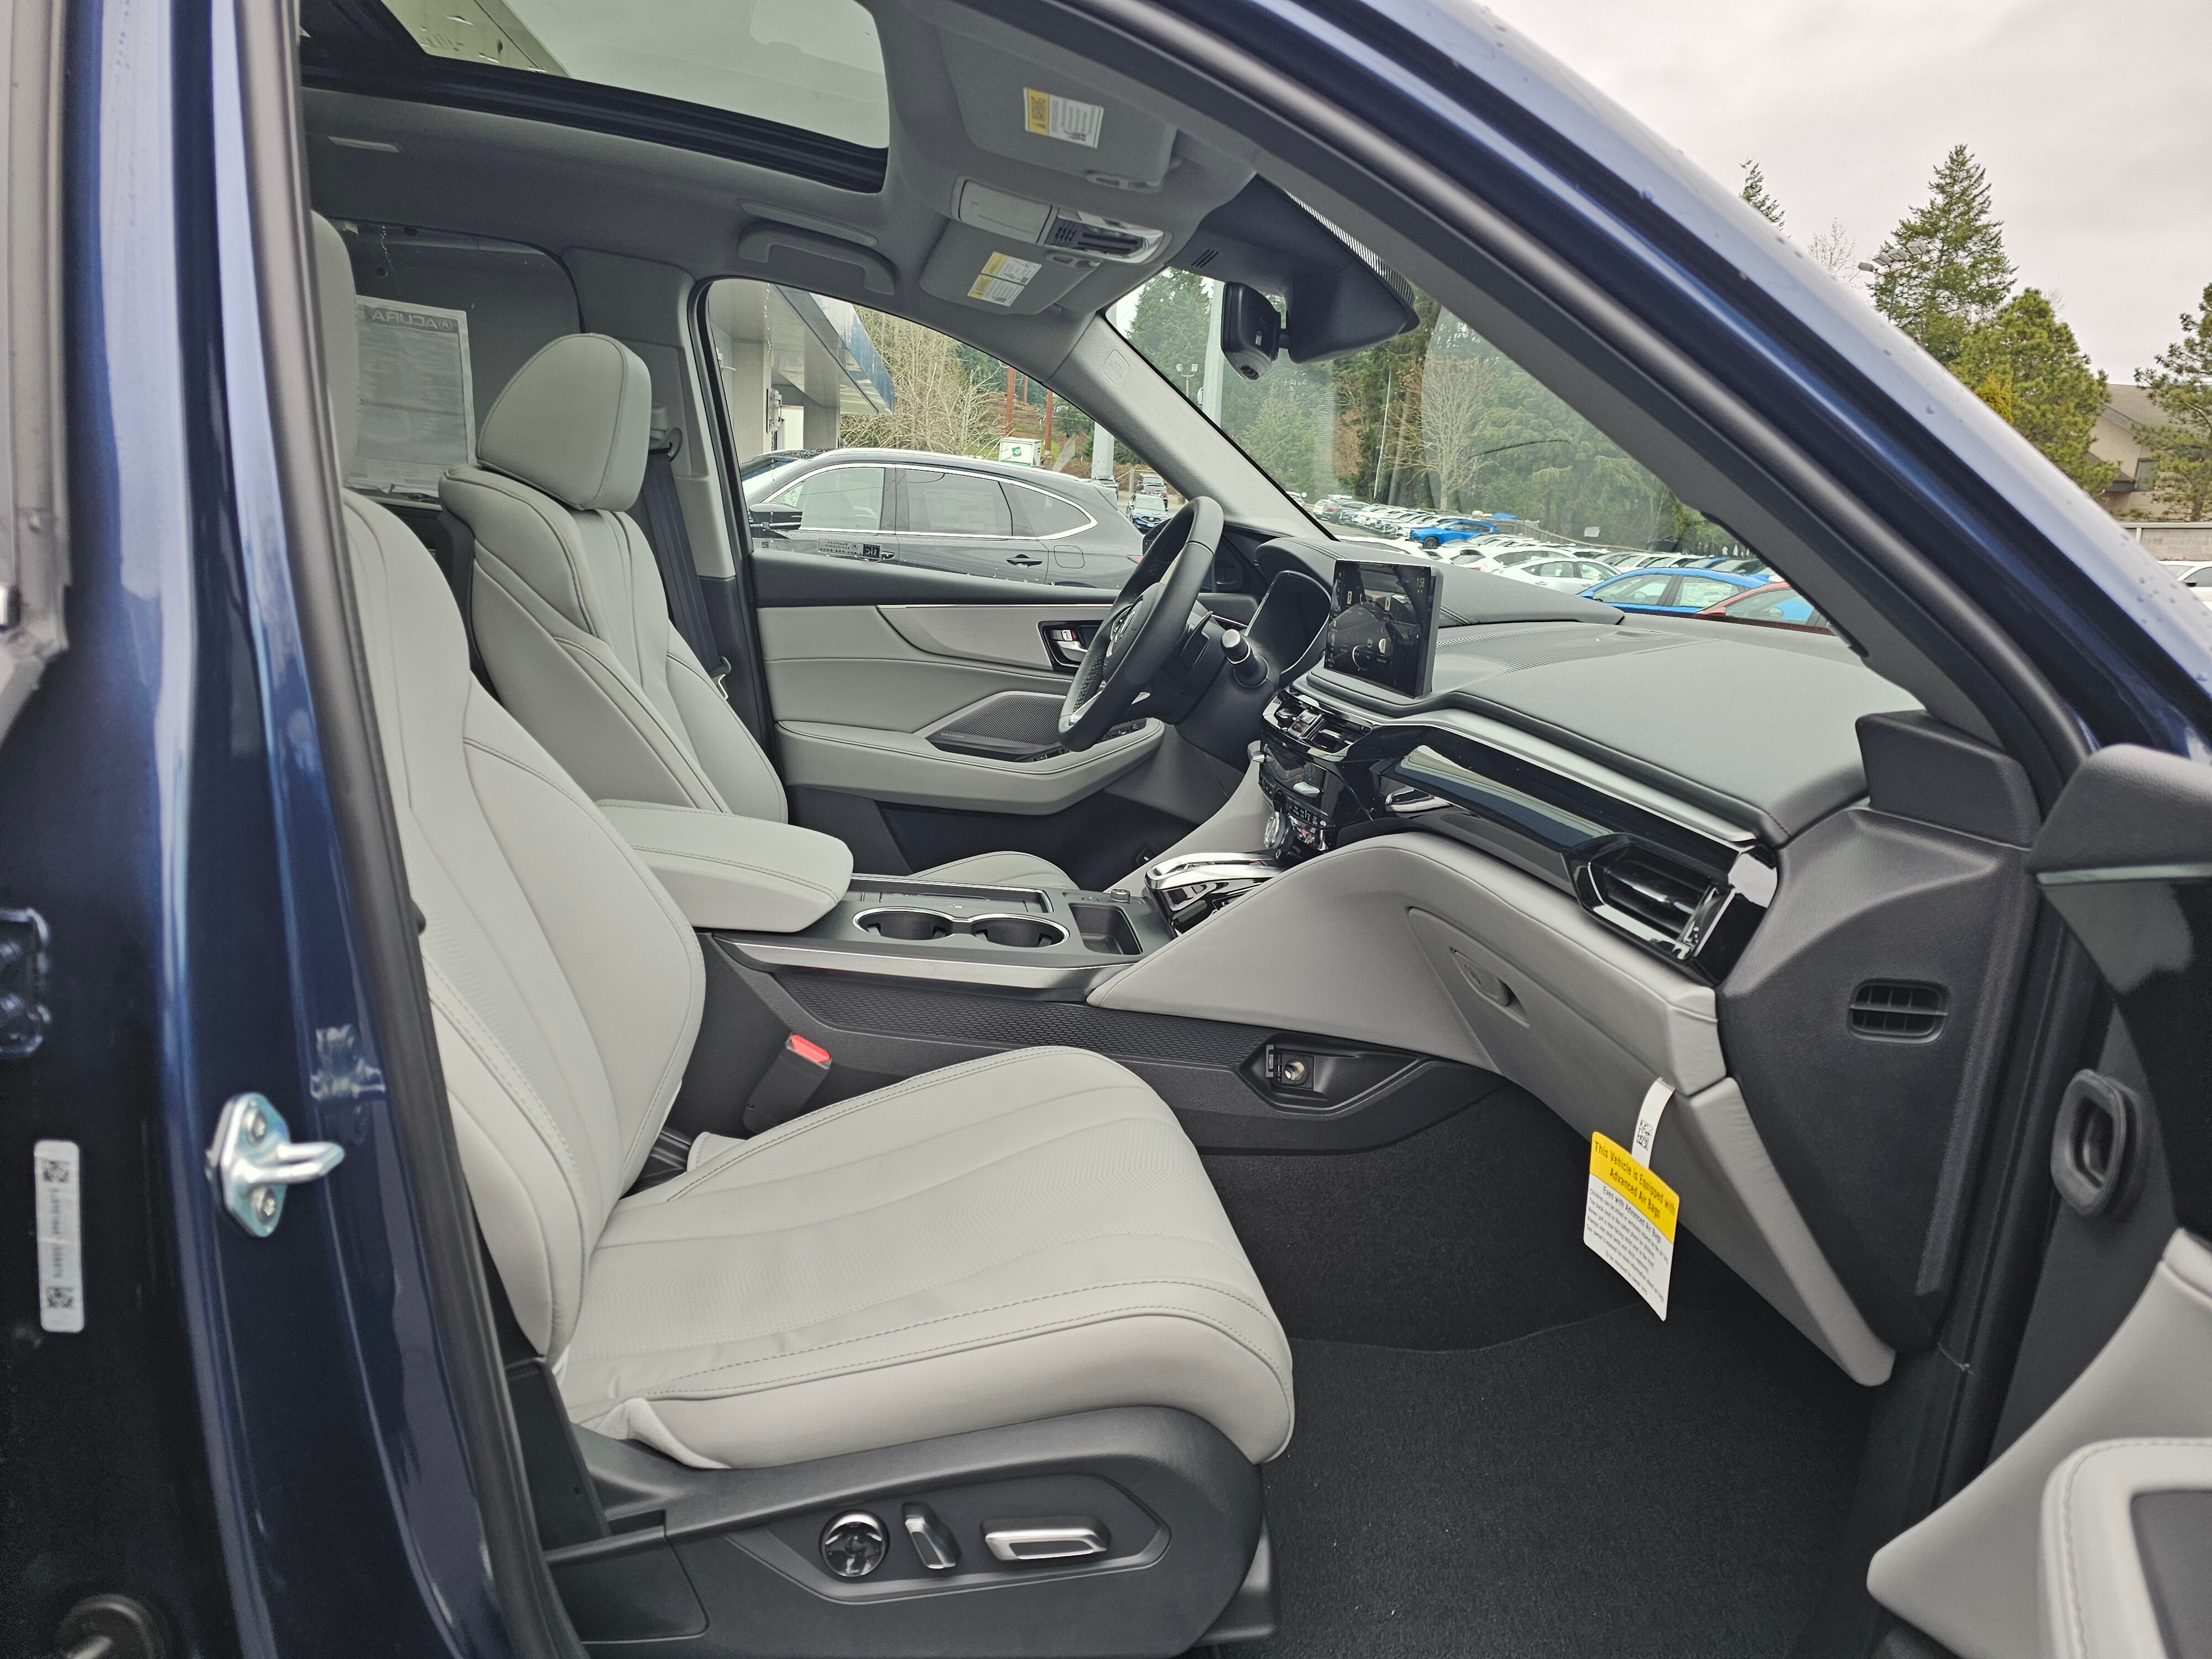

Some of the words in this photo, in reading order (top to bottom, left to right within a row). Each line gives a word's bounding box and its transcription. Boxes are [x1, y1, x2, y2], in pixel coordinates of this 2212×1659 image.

[1594, 1140, 1608, 1159] This
[1610, 1150, 1631, 1176] Vehicle
[1632, 1168, 1638, 1181] is
[1639, 1173, 1663, 1206] Equipped
[1665, 1198, 1675, 1216] with
[1609, 1166, 1637, 1197] Advanced
[1638, 1190, 1646, 1206] Air
[1647, 1198, 1660, 1220] Bags
[1603, 1185, 1614, 1201] Even
[1615, 1195, 1624, 1208] with
[1625, 1203, 1645, 1227] Advanced
